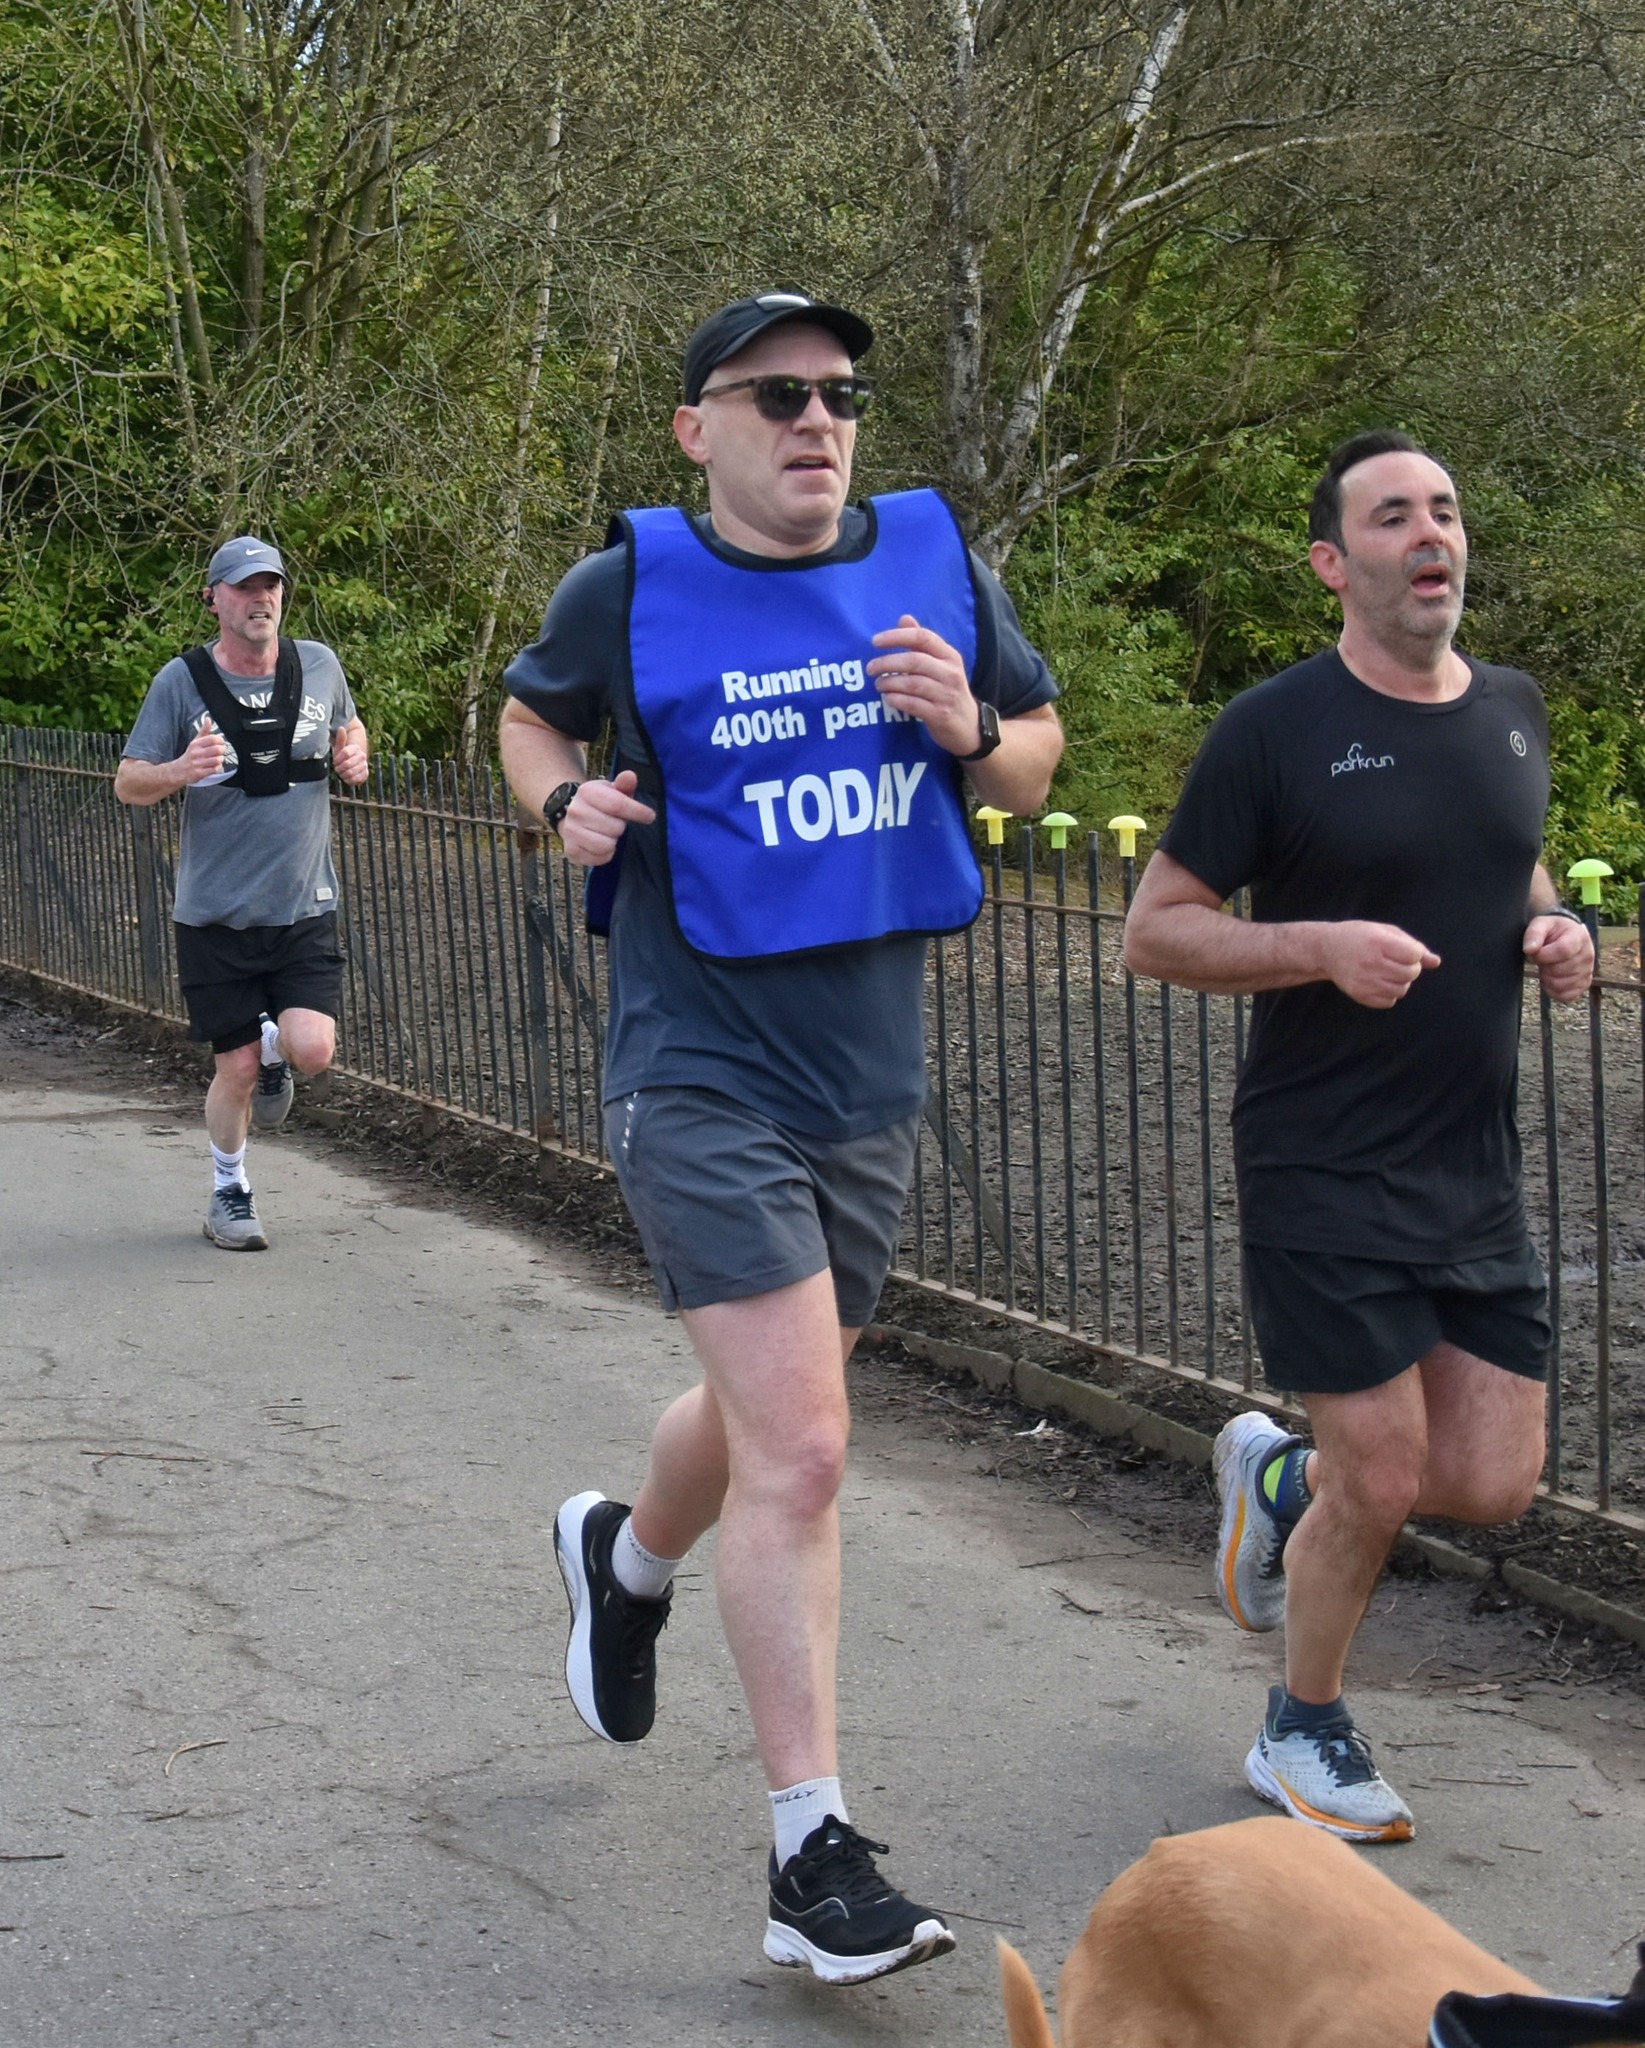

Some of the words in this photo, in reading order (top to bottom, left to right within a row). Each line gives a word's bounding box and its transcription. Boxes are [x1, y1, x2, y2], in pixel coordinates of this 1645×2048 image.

[722, 659, 865, 703] Running
[711, 706, 806, 749] 400th
[824, 692, 924, 739] park
[1331, 743, 1394, 777] parkrun
[743, 762, 927, 847] TODAY
